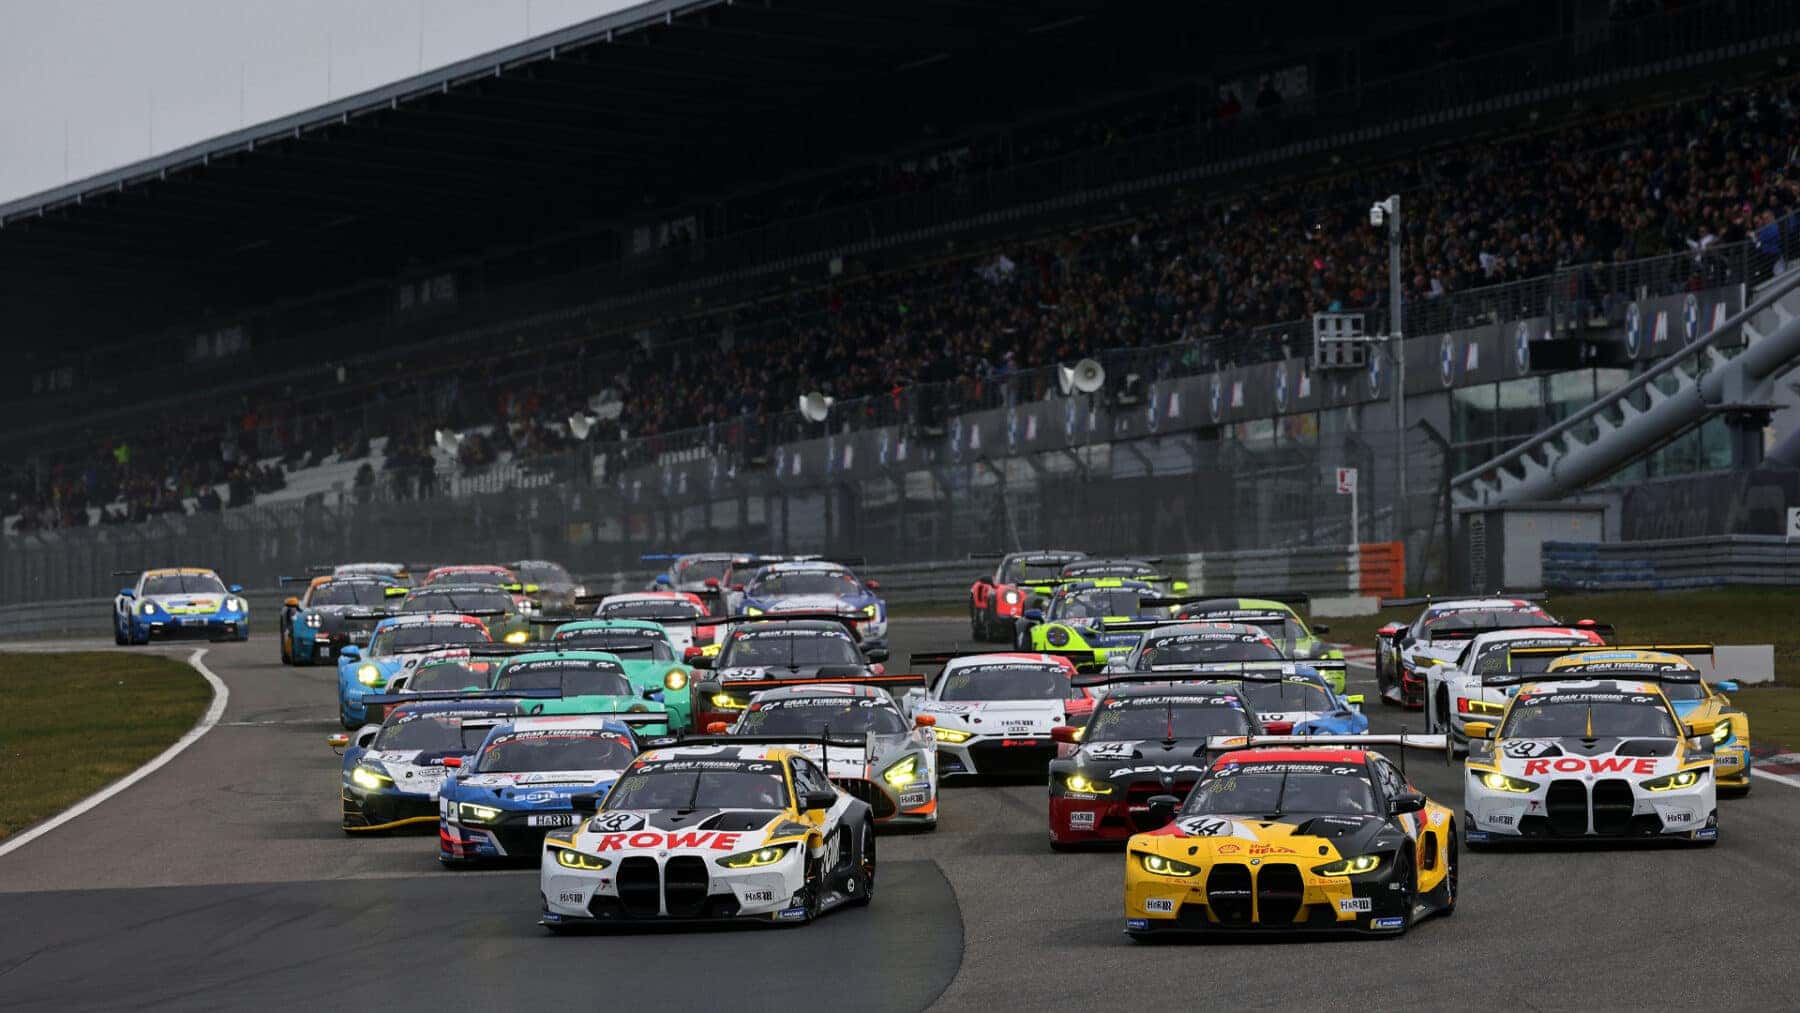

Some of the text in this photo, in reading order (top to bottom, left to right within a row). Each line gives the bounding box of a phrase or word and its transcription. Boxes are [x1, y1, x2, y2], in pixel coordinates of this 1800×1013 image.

[1109, 764, 1207, 779] ADVA
[1242, 765, 1272, 774] GRAN
[1522, 758, 1658, 776] ROWE
[1187, 818, 1226, 835] 44
[597, 832, 742, 852] ROWE
